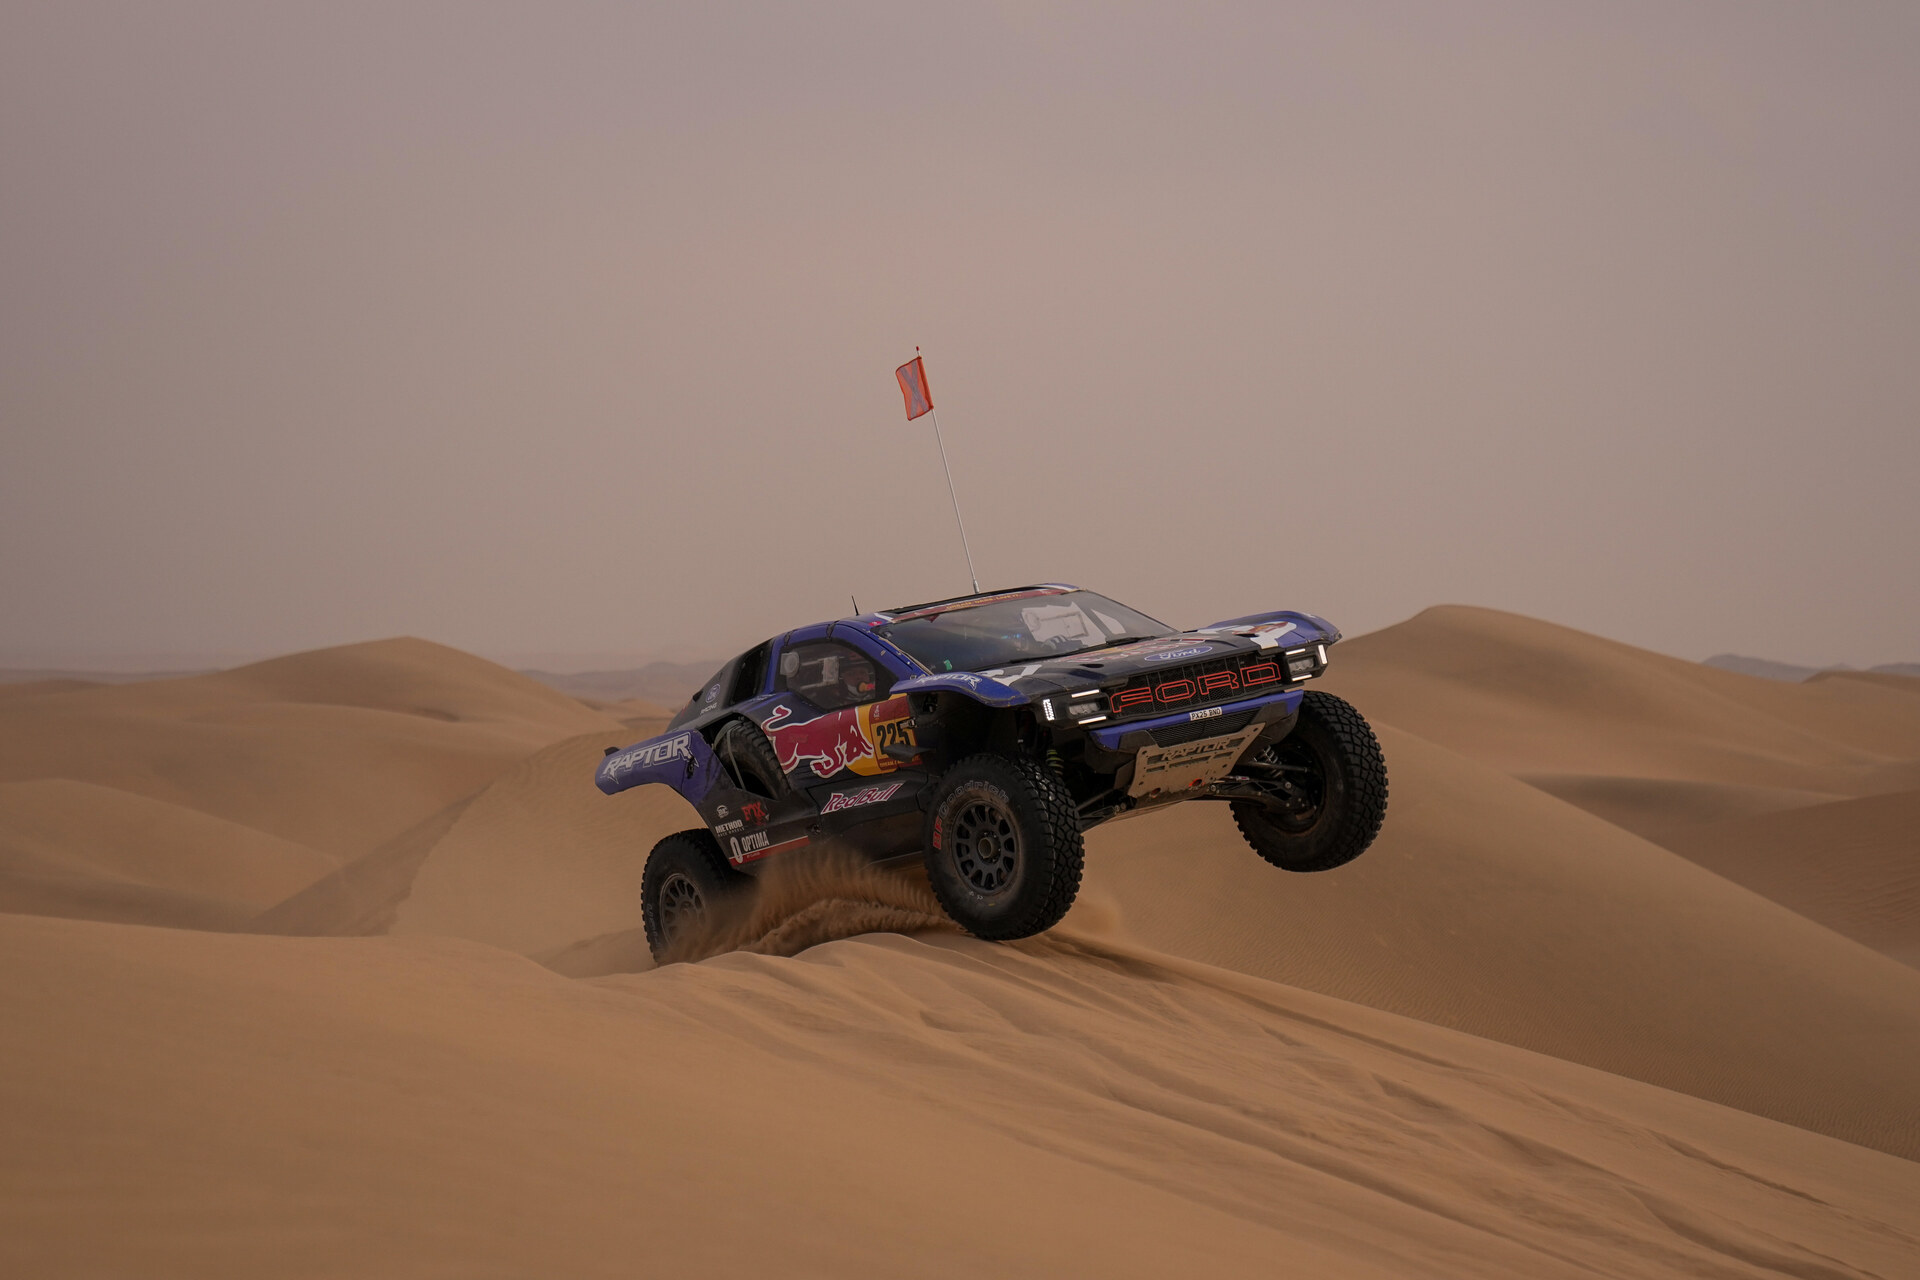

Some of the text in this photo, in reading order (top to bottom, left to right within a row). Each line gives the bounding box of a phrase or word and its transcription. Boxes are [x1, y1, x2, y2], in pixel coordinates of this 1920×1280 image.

[1158, 648, 1201, 660] Ford
[916, 674, 983, 690] RAPTOR
[1110, 662, 1281, 713] FORD
[876, 721, 912, 755] 225
[602, 733, 697, 782] RAPTOR
[1161, 739, 1231, 761] RAPTOR
[715, 819, 744, 834] METHOD
[741, 831, 770, 852] OPTIMA
